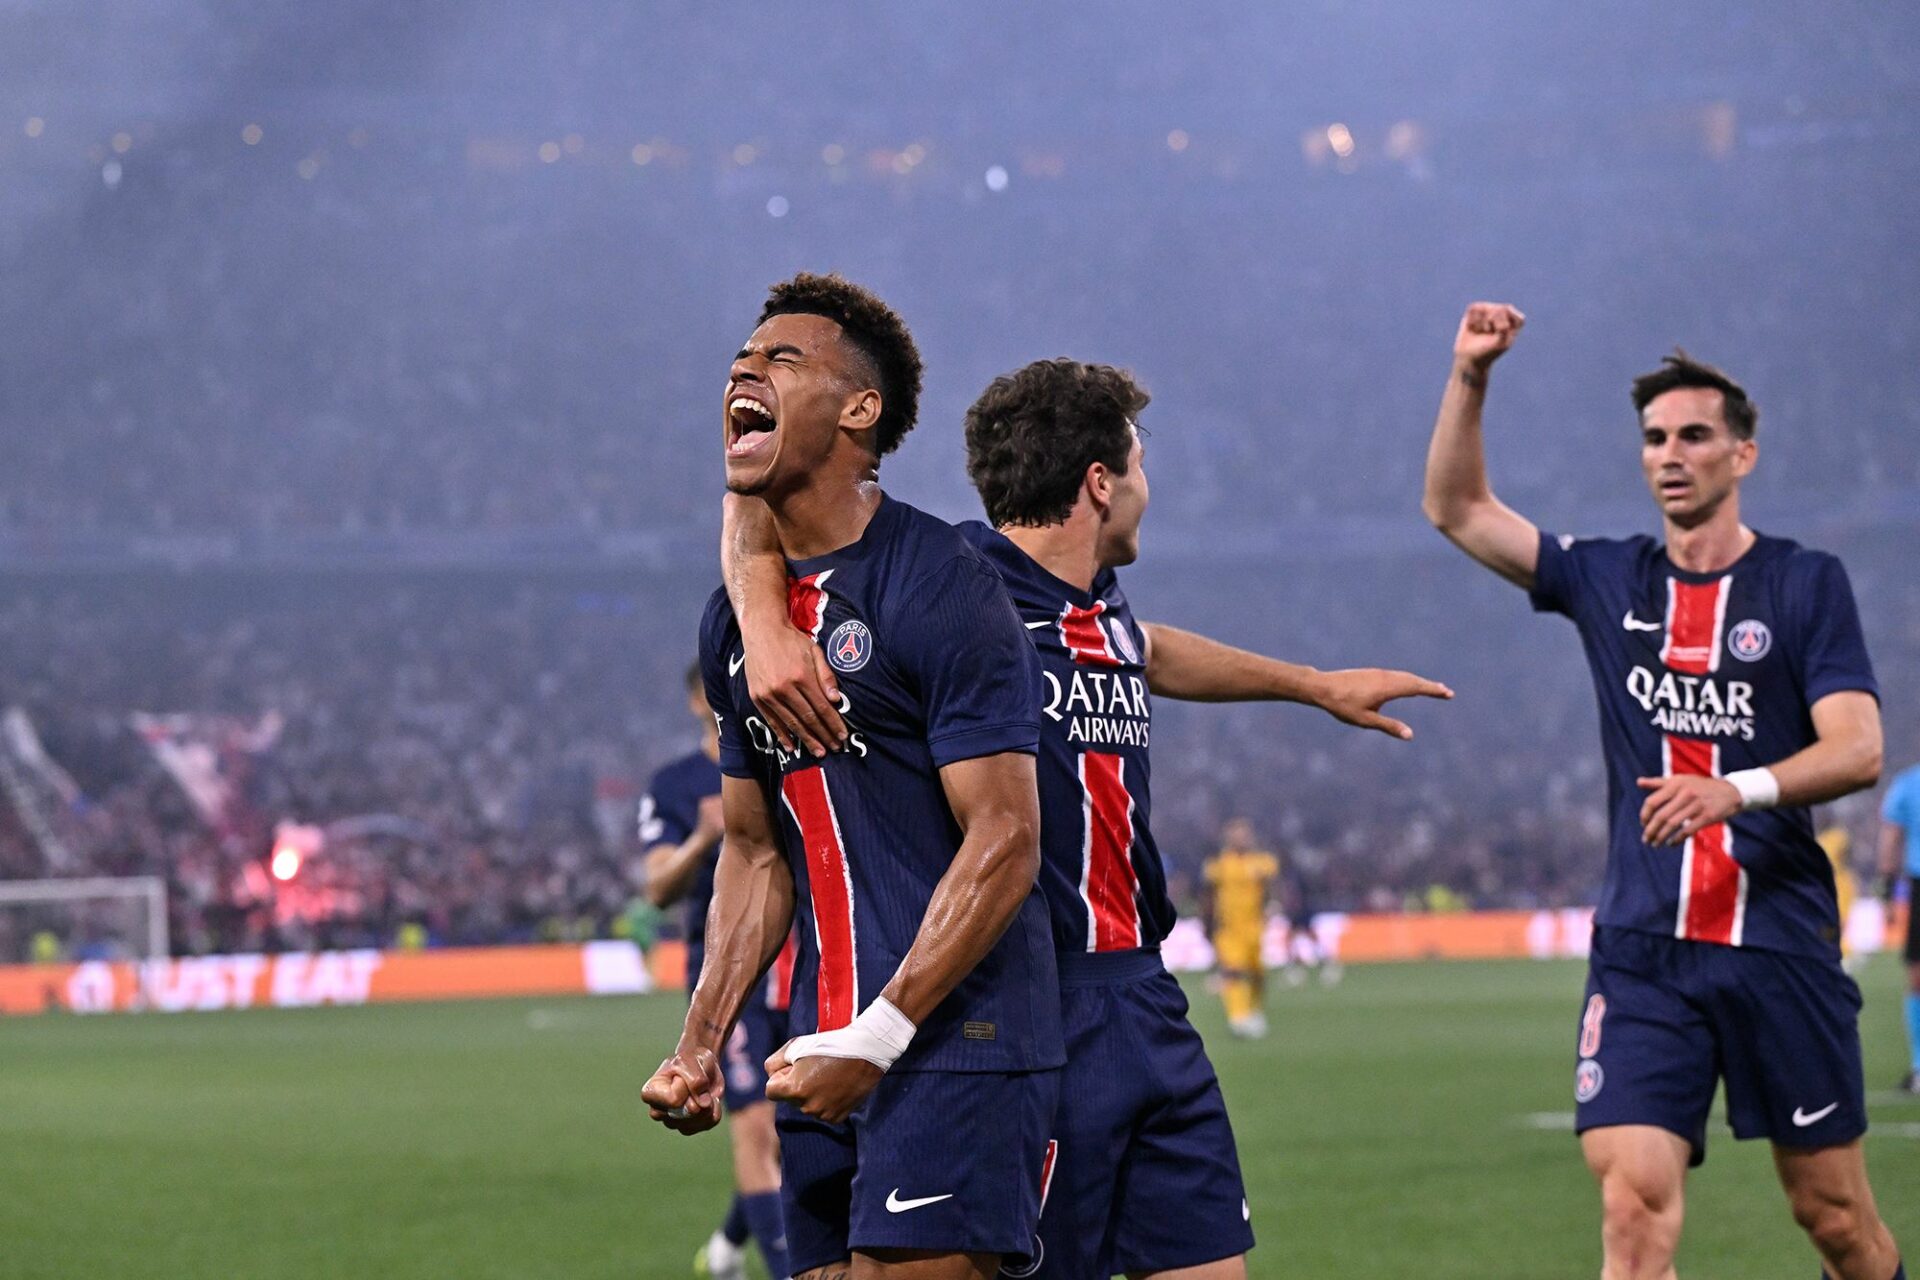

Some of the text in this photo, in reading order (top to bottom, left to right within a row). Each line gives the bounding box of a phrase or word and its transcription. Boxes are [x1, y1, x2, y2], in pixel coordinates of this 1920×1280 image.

[839, 623, 867, 637] PARIS
[1043, 670, 1149, 722] QATAR
[1626, 665, 1755, 716] QATAR
[1067, 716, 1149, 748] AIRWAYS
[1651, 706, 1755, 741] AIRWAYS
[271, 949, 382, 1007] EAT
[1579, 993, 1607, 1059] 8
